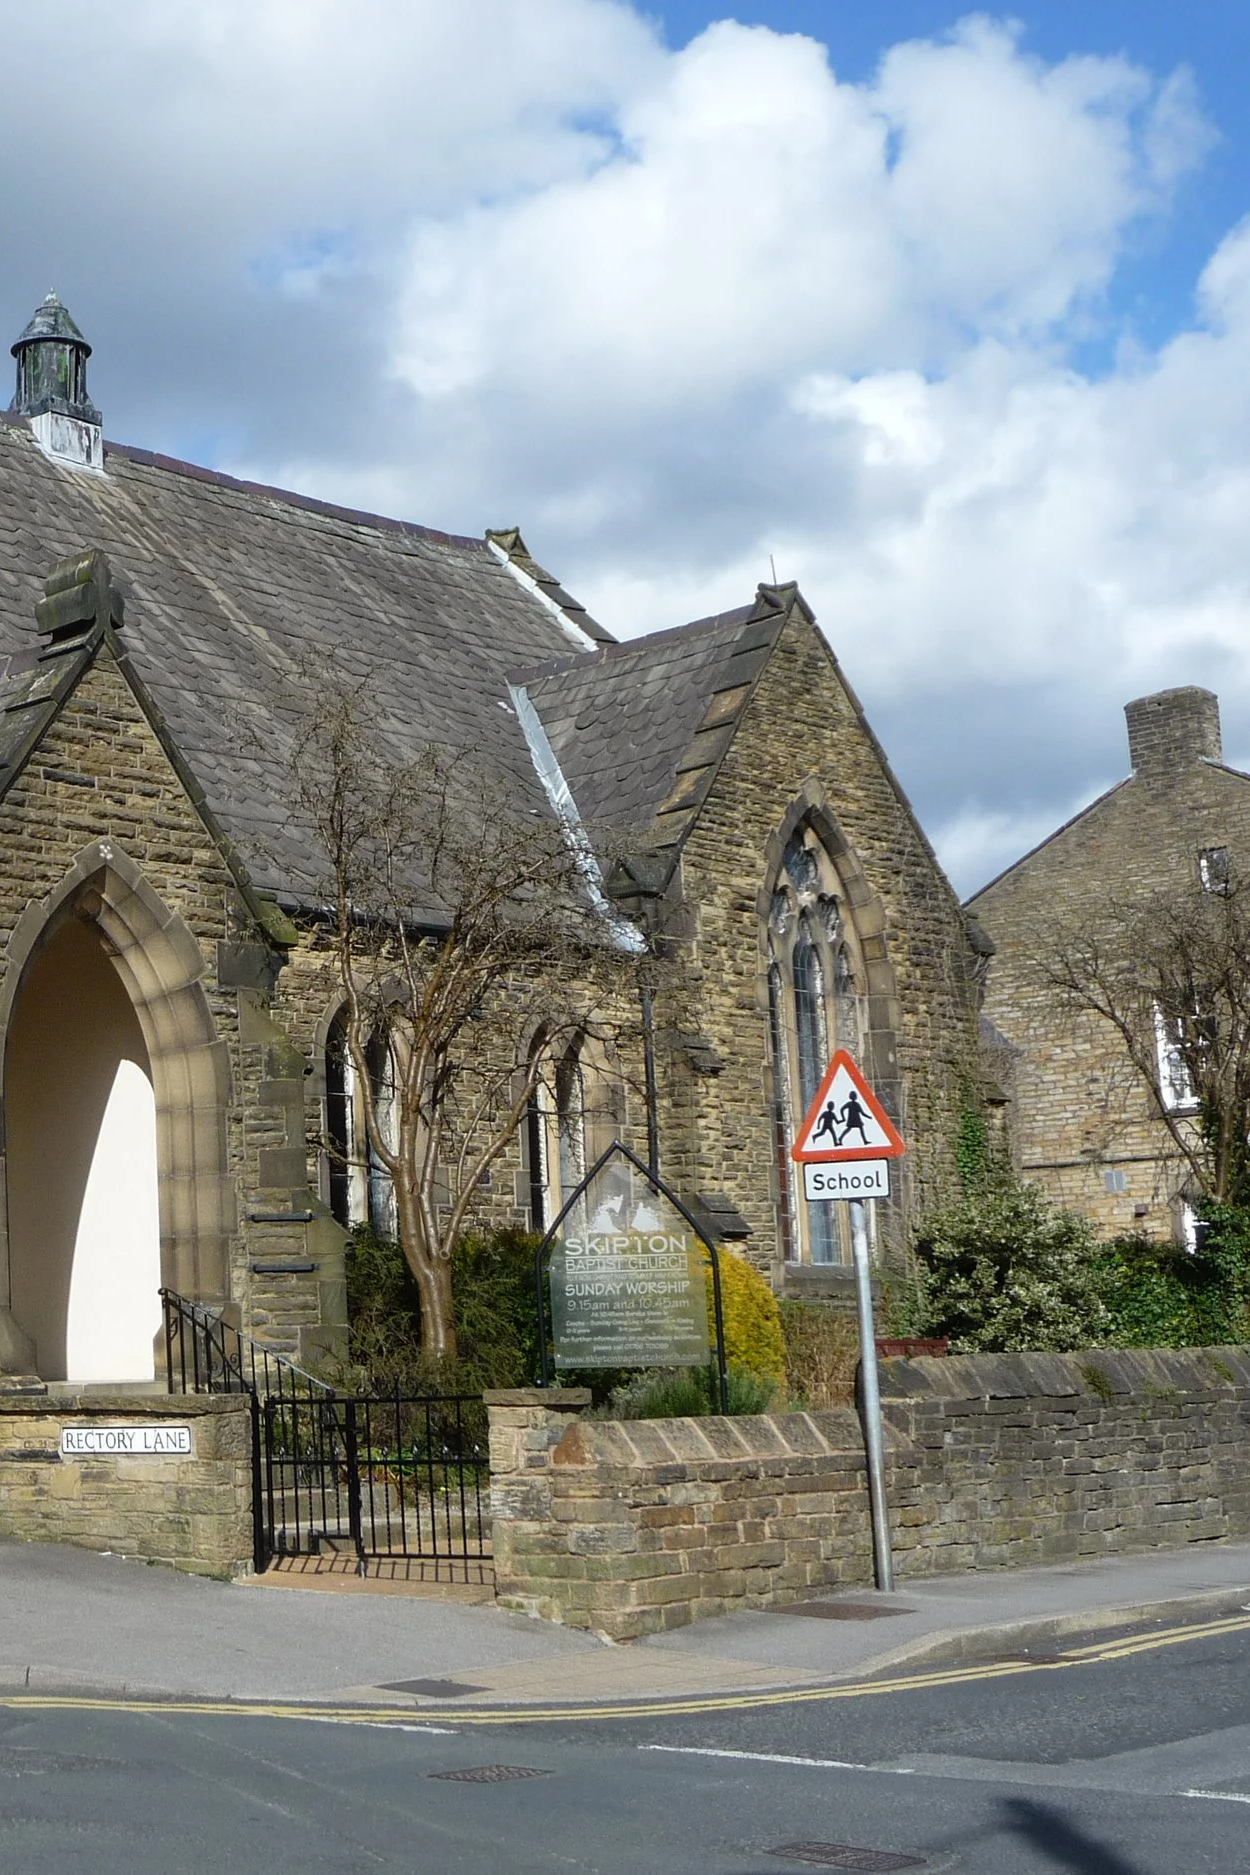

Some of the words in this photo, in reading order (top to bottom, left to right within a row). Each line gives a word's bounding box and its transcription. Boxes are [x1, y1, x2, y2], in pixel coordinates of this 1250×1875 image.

[813, 1171, 882, 1191] School
[565, 1235, 687, 1255] SKIPTON
[566, 1259, 622, 1271] BAPTIST
[628, 1256, 688, 1270] CHURCH
[565, 1282, 623, 1297] SUNDAY
[626, 1280, 690, 1295] WORSHIP
[566, 1299, 610, 1311] 9.15am
[613, 1298, 635, 1310] and
[66, 1431, 136, 1449] RECTORY
[144, 1431, 186, 1449] LANE
